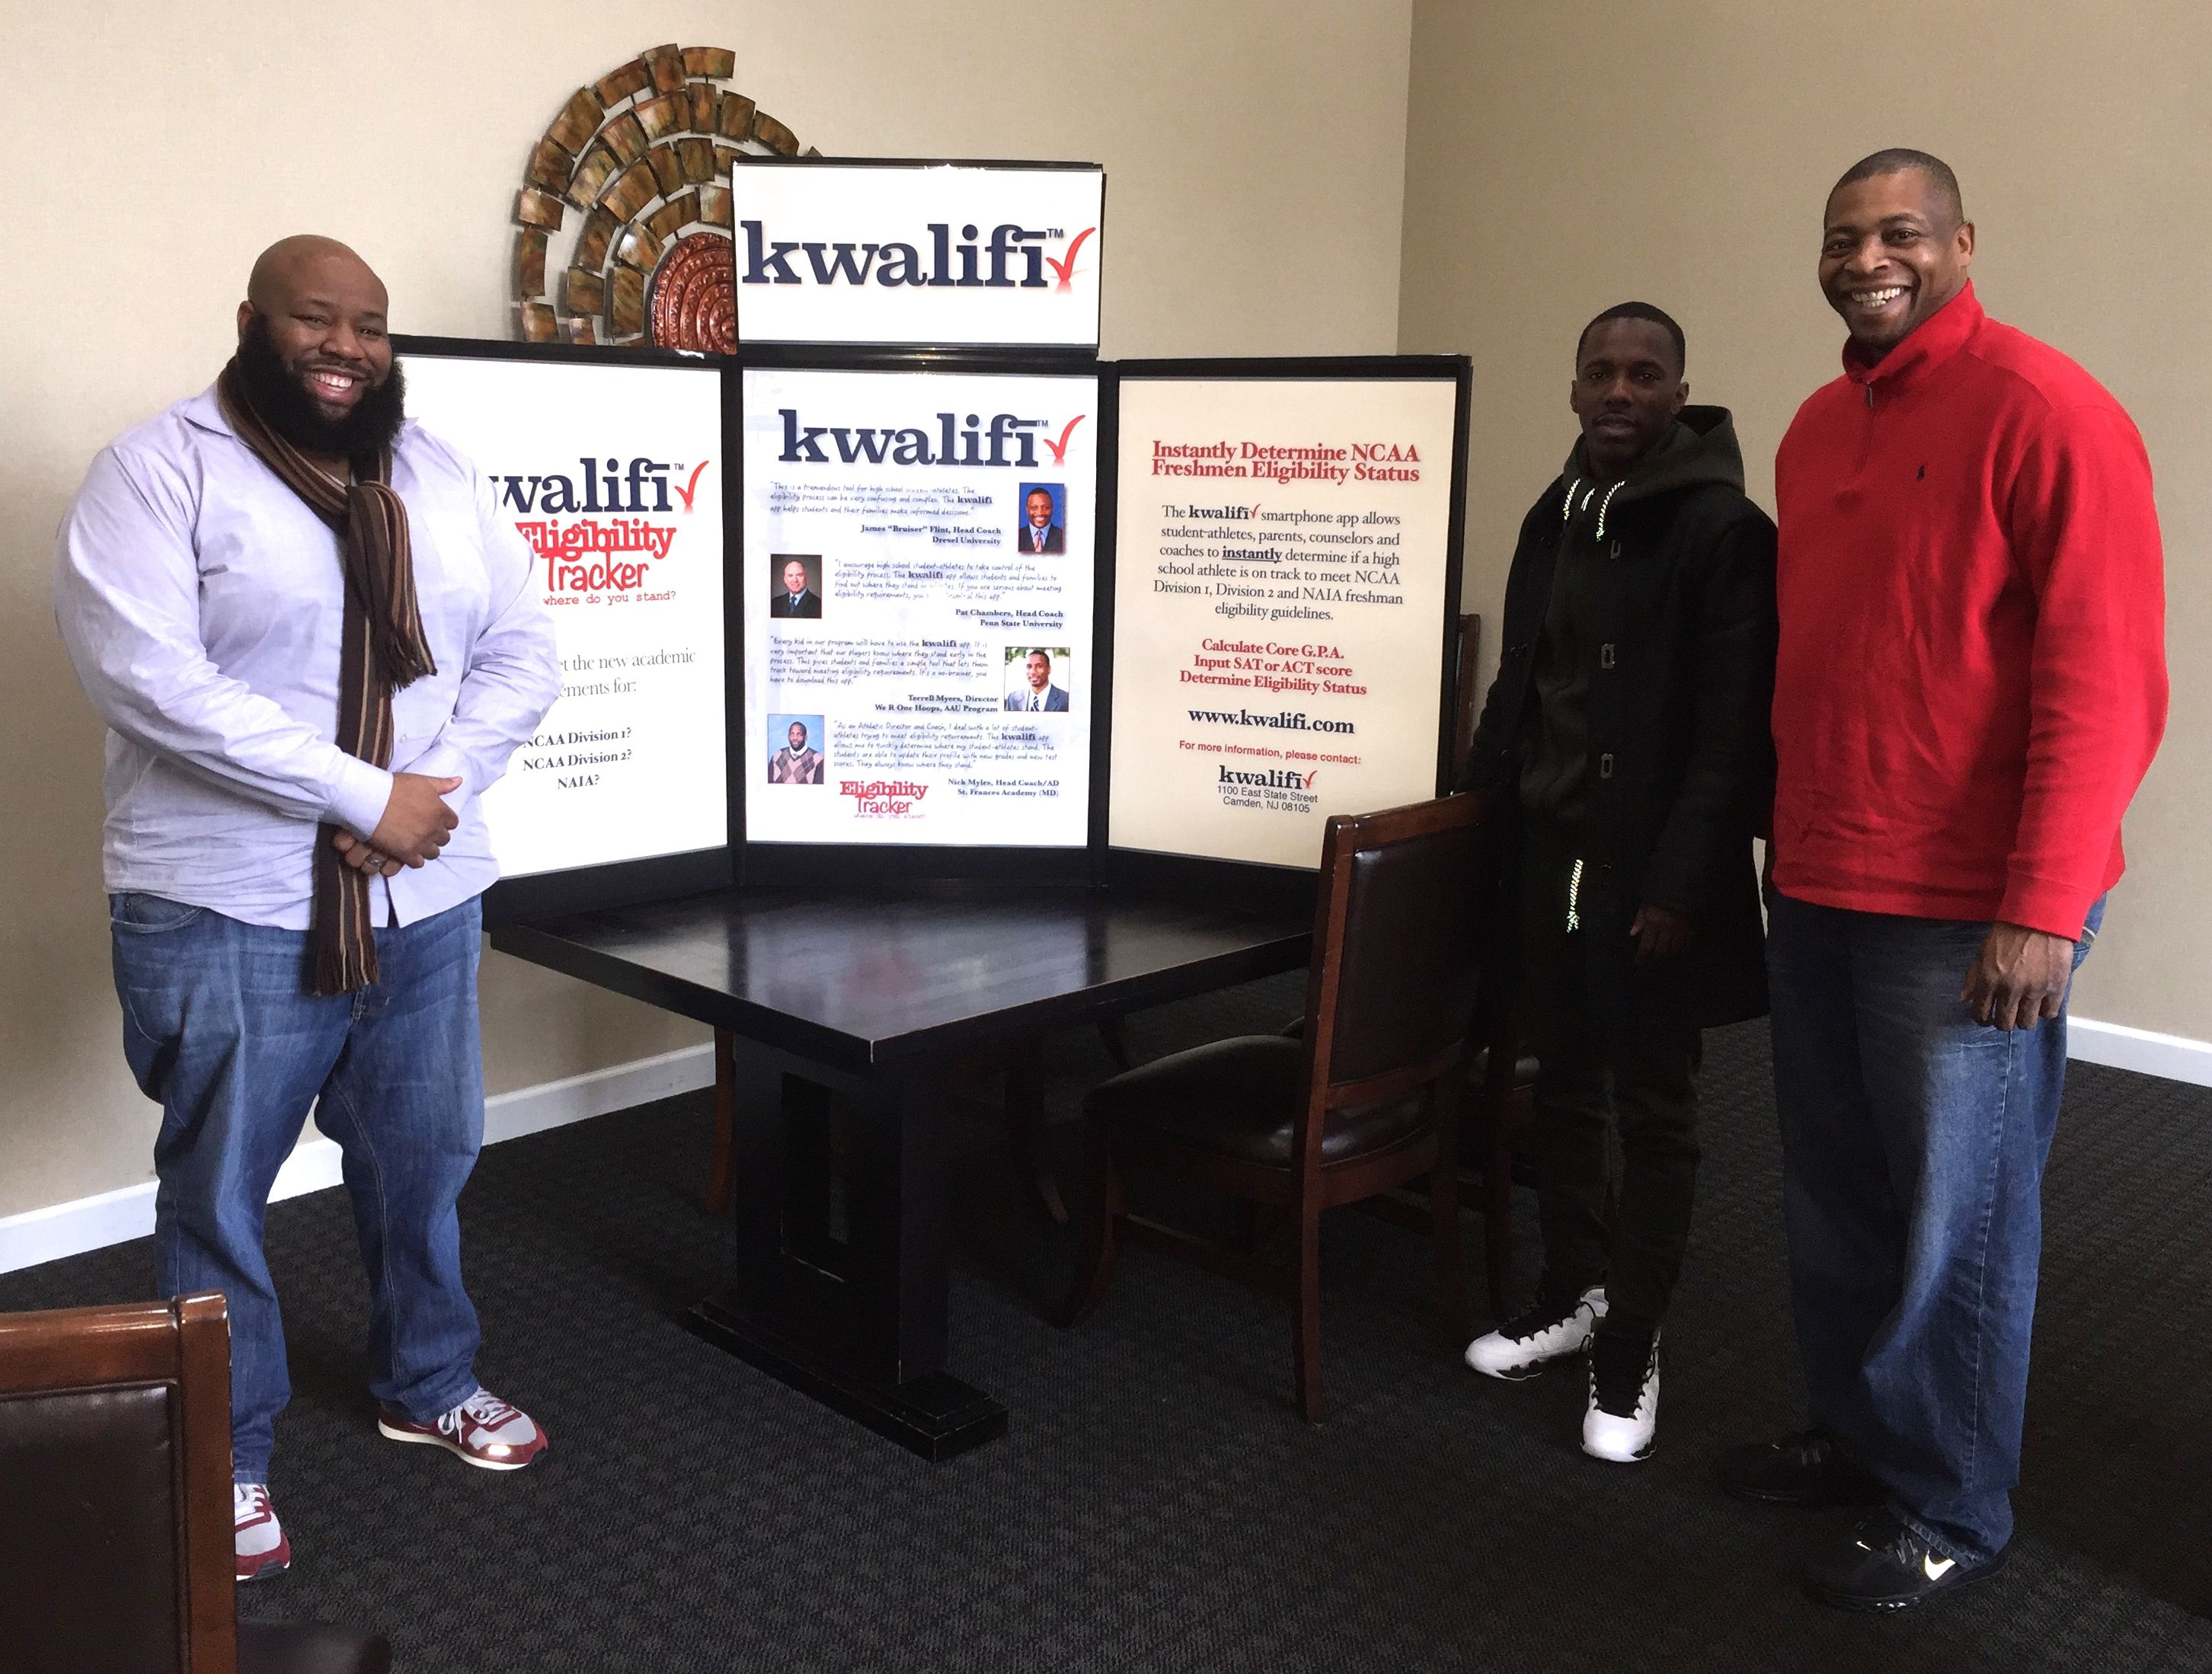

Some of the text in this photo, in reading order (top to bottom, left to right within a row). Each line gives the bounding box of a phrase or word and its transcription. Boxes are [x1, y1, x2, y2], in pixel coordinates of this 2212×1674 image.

[740, 221, 1048, 287] kwalifi
[778, 409, 1038, 468] kwalifi
[1152, 440, 1420, 464] Instantly Determine NCAA
[1152, 459, 1420, 485] Freshmen Eligibility Status
[1162, 505, 1401, 526] The kwalifi smartphone app allows
[861, 525, 886, 533] James
[1161, 527, 1400, 546] student-athletes, parents, counselors and
[961, 537, 1001, 545] University
[1160, 545, 1400, 568] coaches to instantly determine if a high
[540, 551, 649, 592] Tracker
[1158, 564, 1400, 585] school athlete is on track to meet NCAA
[543, 591, 676, 605] where do you stand?
[1154, 580, 1201, 593] Division
[1216, 583, 1264, 597] Division
[1268, 589, 1274, 598] 2
[1277, 587, 1299, 599] and
[1303, 587, 1342, 602] NAIA
[1345, 589, 1402, 604] freshman
[1215, 603, 1334, 620] eligibility guidelines.
[599, 658, 627, 669] new
[633, 647, 695, 666] academic
[1202, 639, 1344, 659] Calculate Core G.P.A.
[1194, 655, 1230, 670] Input
[1234, 657, 1263, 669] SAT
[1281, 661, 1315, 673] ACT
[1316, 666, 1352, 676] score
[614, 677, 636, 693] for:
[1180, 670, 1367, 695] Determine Eligibility Status
[1188, 709, 1354, 734] www.kwalifi.com
[568, 730, 619, 744] Division
[622, 727, 631, 739] 1?
[523, 749, 631, 771] NCAA Division 2?
[1180, 740, 1360, 764] For more information, please contact:
[558, 775, 599, 789] NAIA?
[1219, 765, 1302, 789] kwalifi
[839, 781, 929, 799] Eligibility
[1217, 786, 1318, 803] 1100 East State Street
[858, 795, 913, 814] Tracker
[1223, 797, 1310, 813] Camden, NJ 08105
